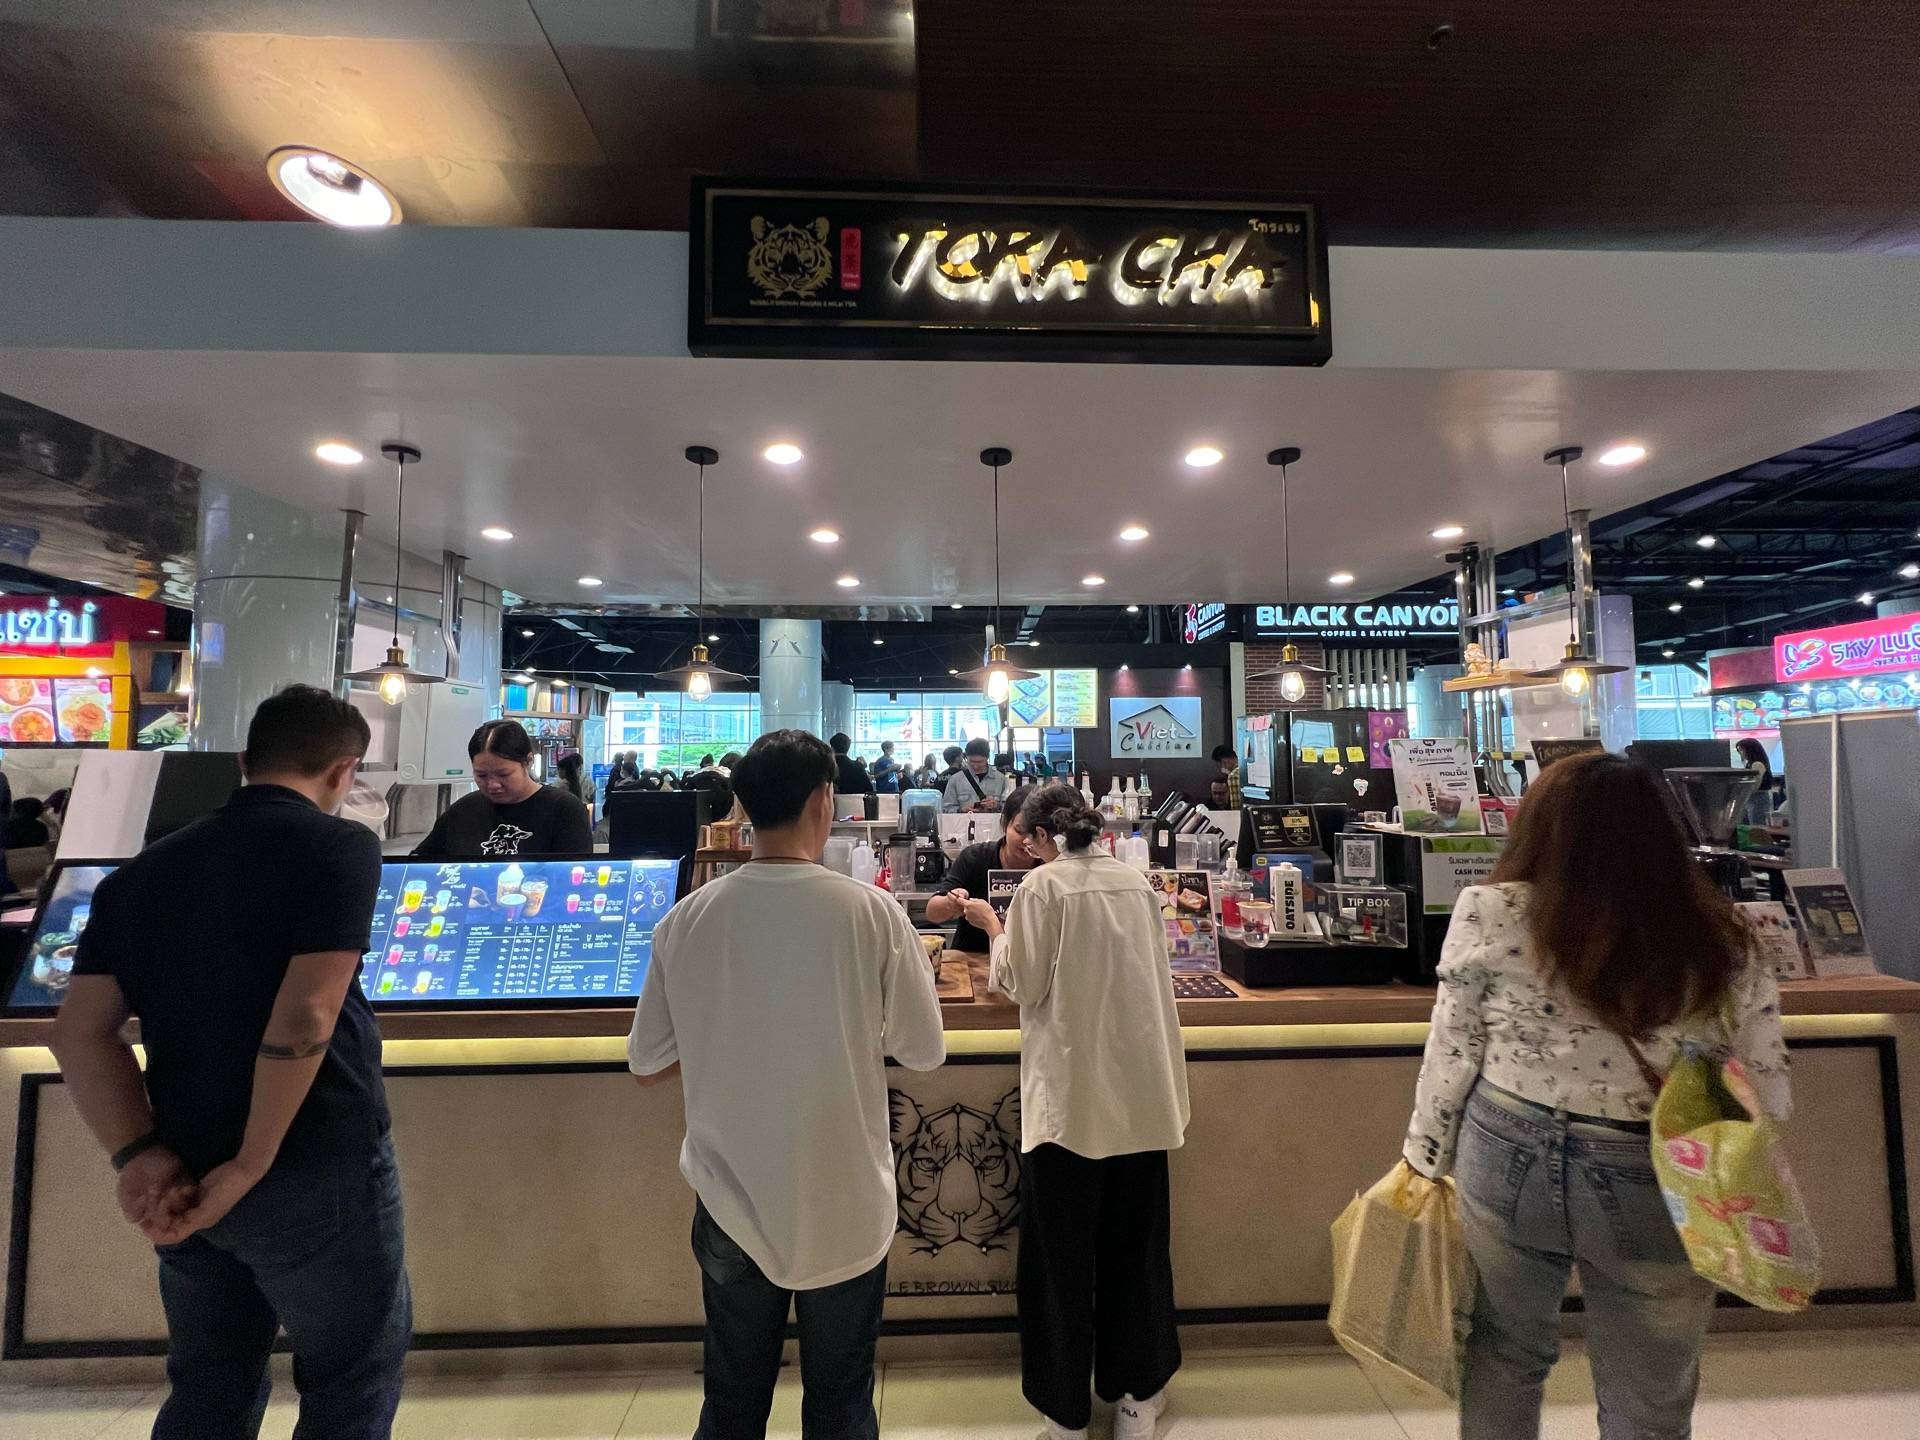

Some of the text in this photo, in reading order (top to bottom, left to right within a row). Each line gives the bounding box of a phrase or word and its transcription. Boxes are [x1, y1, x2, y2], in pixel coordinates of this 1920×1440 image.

[891, 223, 1284, 304] TORA CHA
[1256, 606, 1348, 627] BLACK
[1830, 638, 1875, 666] SKY
[1135, 721, 1177, 740] Viet
[1120, 733, 1192, 752] Cuisine
[991, 883, 1018, 893] CROF
[1285, 880, 1296, 930] OATSIDE
[1347, 897, 1390, 908] TIP BOX
[986, 1280, 1018, 1293] SU
